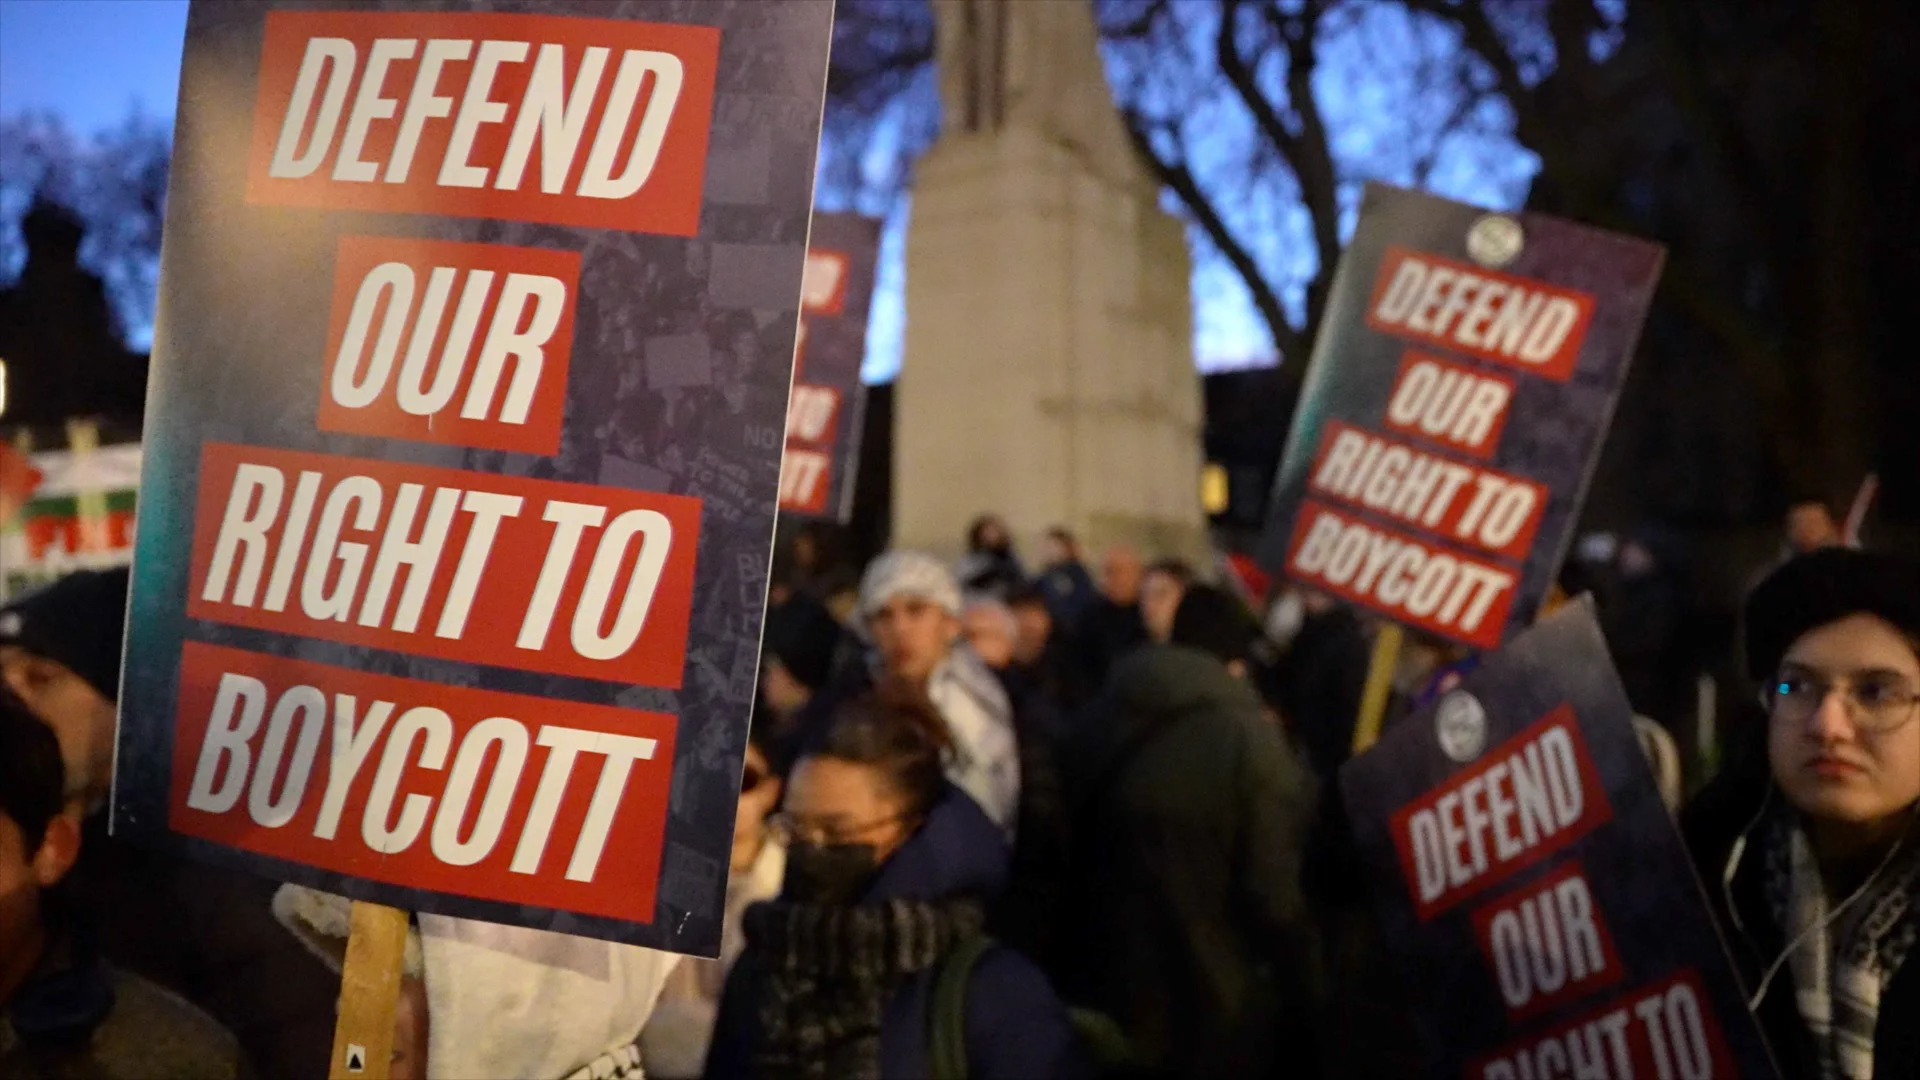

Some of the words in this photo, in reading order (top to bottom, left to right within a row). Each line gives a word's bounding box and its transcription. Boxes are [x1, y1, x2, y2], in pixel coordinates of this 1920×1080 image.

[268, 37, 684, 200] DEFEND
[331, 261, 566, 425] OUR
[1374, 257, 1579, 364] DEFEND
[1386, 360, 1510, 447] OUR
[1314, 429, 1473, 528] RIGHT
[1455, 474, 1537, 549] TO
[203, 463, 523, 640] RIGHT
[516, 499, 672, 660] TO
[1294, 512, 1513, 633] BOYCOTT
[189, 672, 657, 883] BOYCOTT
[1409, 724, 1585, 904] DEFEND
[1490, 874, 1606, 1007] OUR
[1633, 982, 1713, 1080] TO
